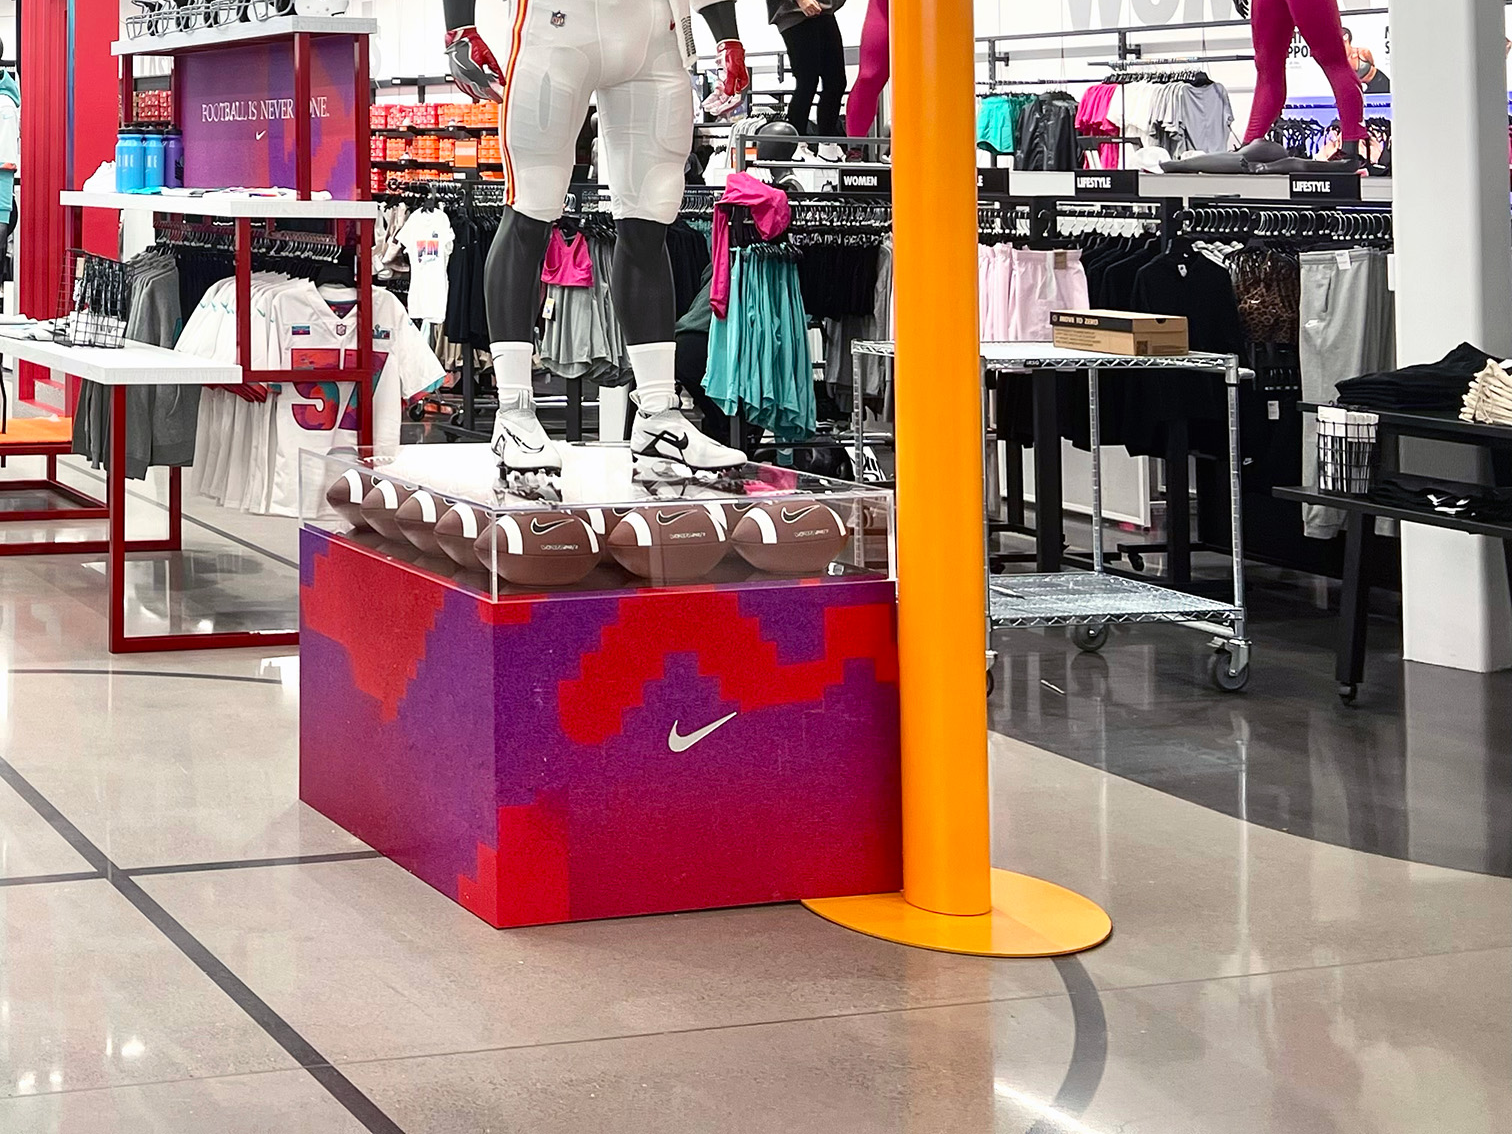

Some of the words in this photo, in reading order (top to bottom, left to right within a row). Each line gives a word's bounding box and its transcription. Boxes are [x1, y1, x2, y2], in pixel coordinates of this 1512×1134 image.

[202, 100, 247, 122] FOOTBALL
[248, 100, 257, 120] IS
[260, 98, 294, 120] NEVER
[843, 175, 877, 186] WOMEN
[1076, 176, 1112, 189] LIFESTYLE
[1292, 180, 1330, 193] LIFESTYLE
[1059, 315, 1075, 324] MOVE
